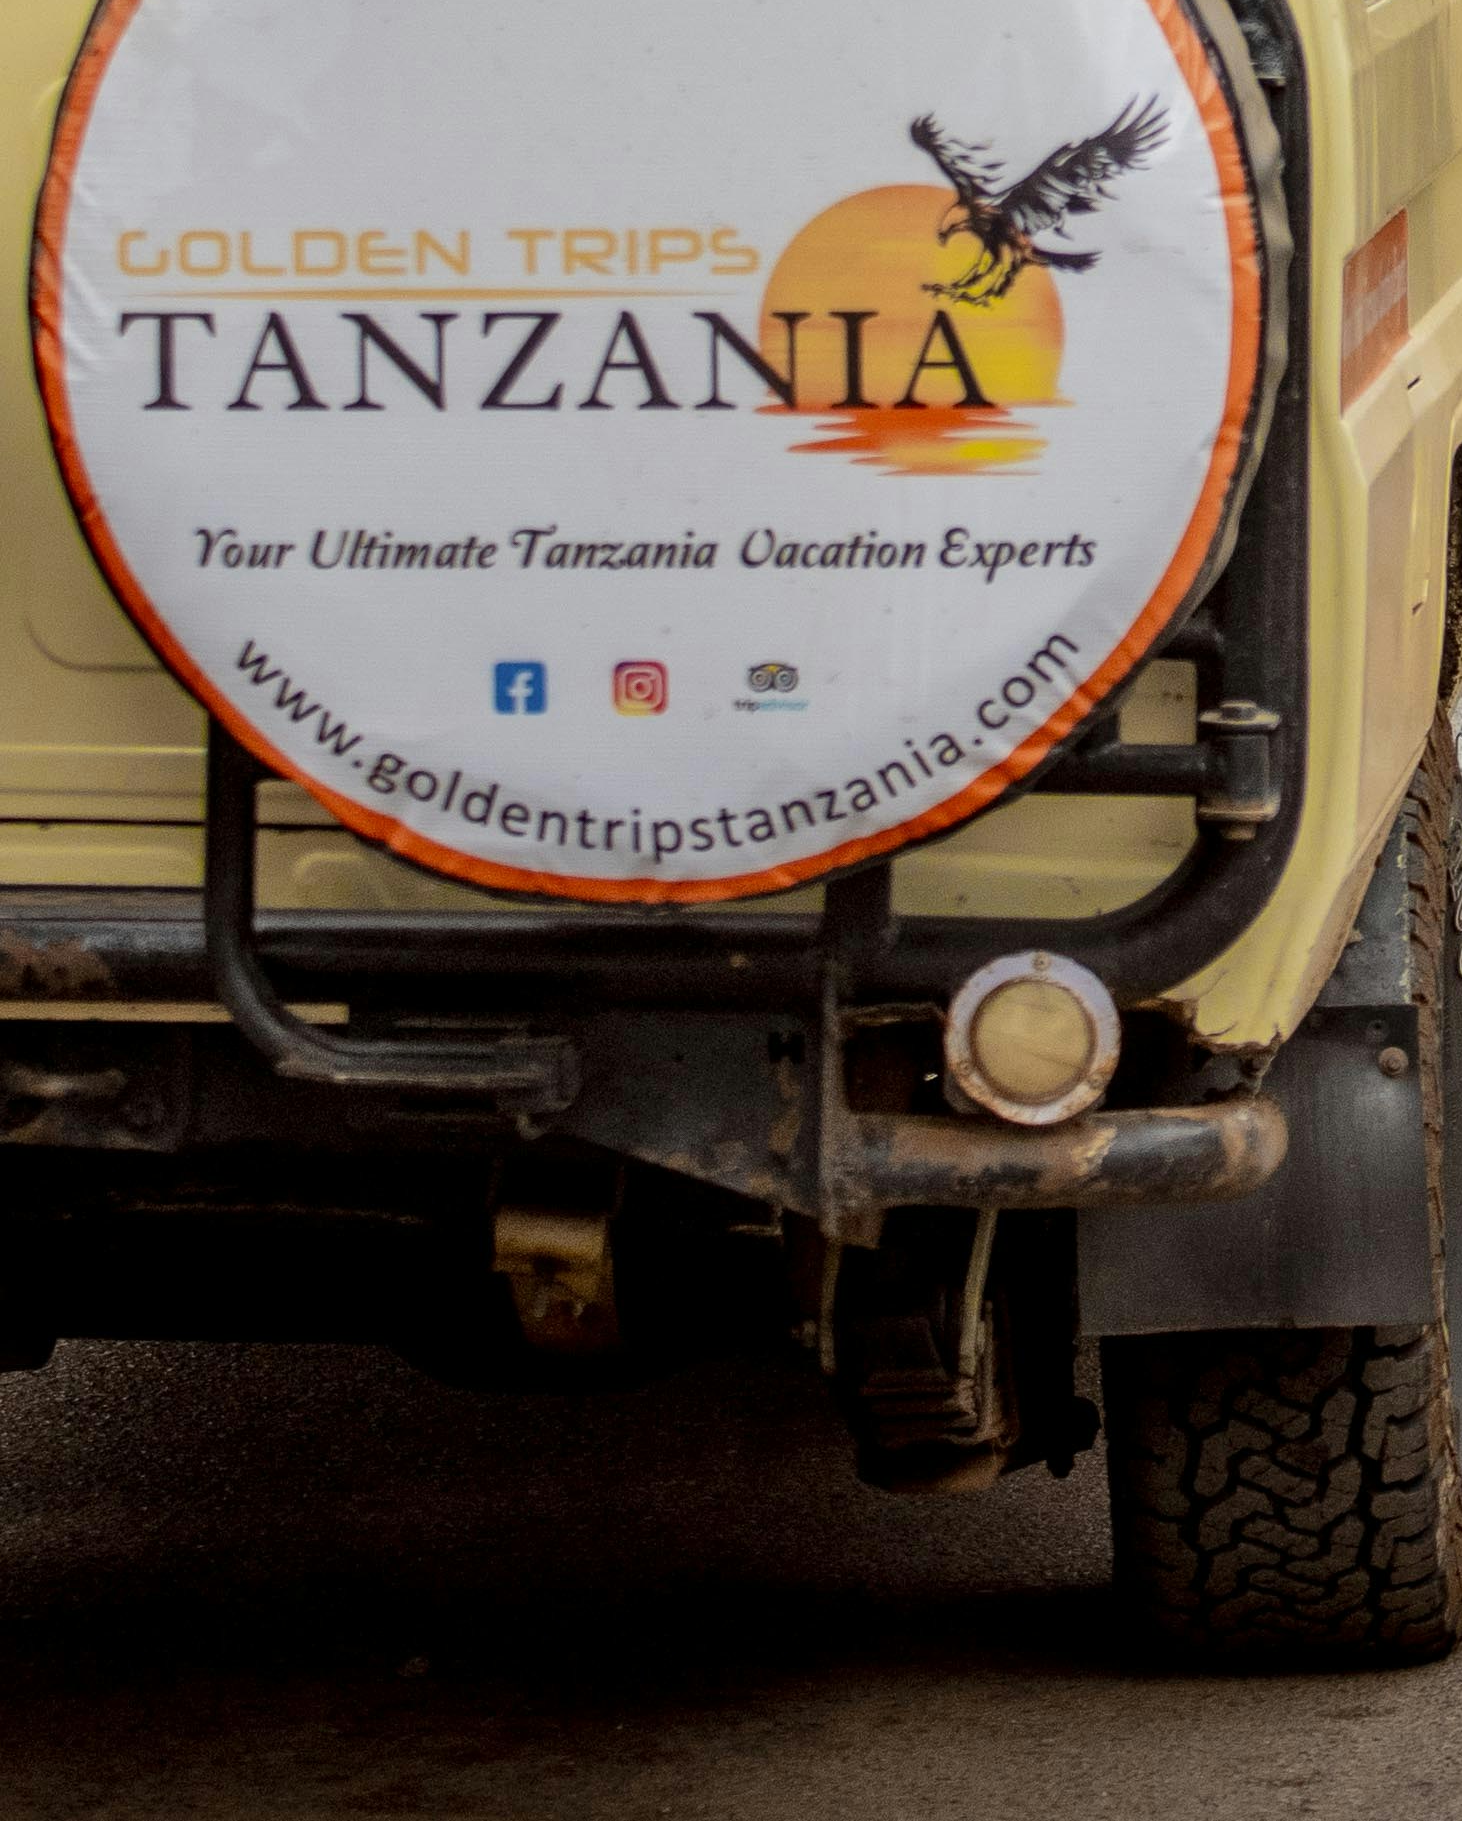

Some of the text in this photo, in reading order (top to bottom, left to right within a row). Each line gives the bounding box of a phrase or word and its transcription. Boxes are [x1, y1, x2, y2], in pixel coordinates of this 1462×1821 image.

[116, 228, 760, 276] GOLDEN TRIPS
[118, 310, 998, 412] TANZANIA
[196, 525, 1098, 584] Your Ultimate Tanzania Vacation Experts
[237, 631, 1081, 861] www.goldentripstanzania.com
